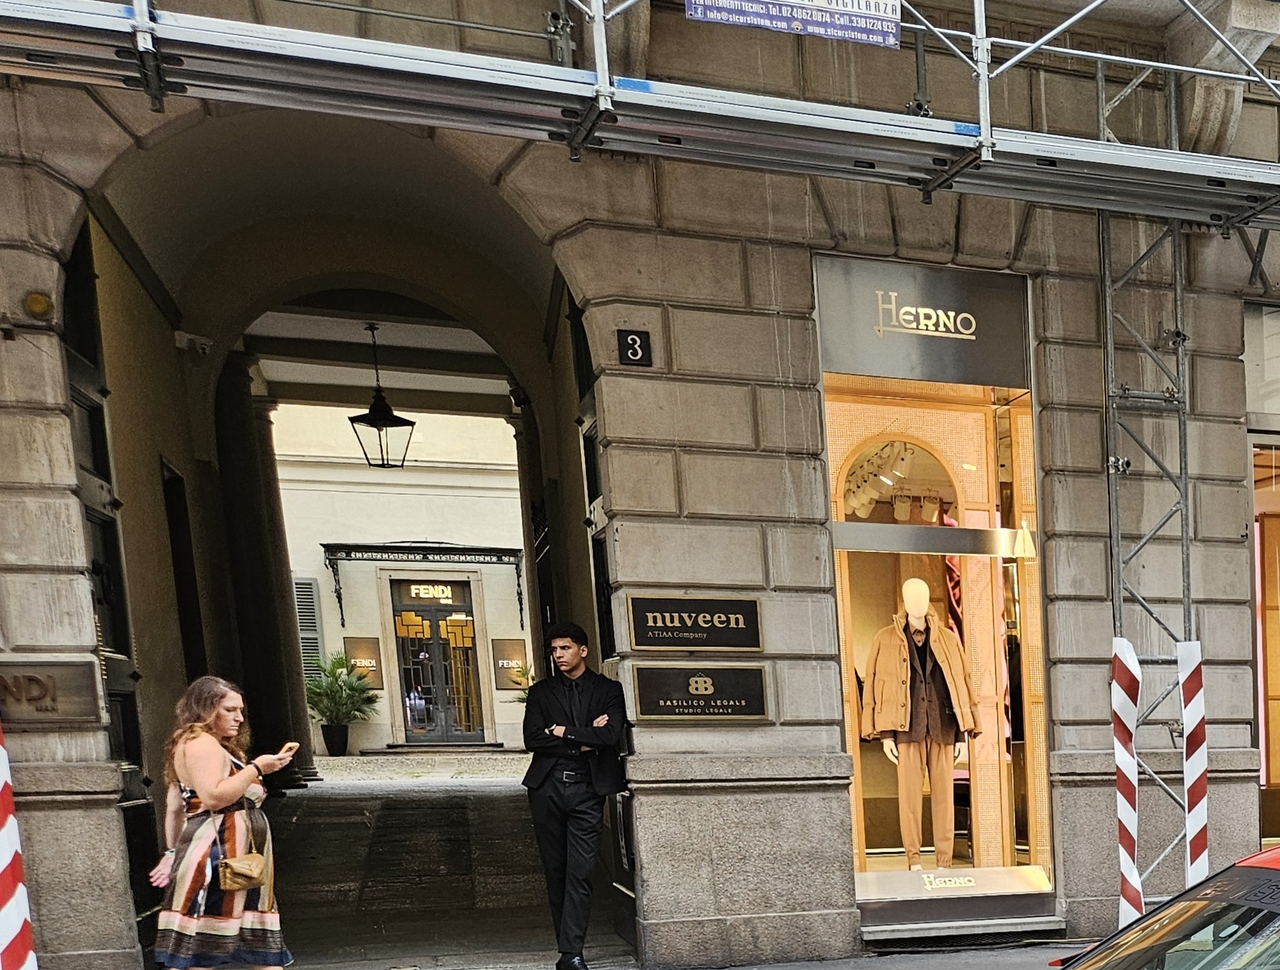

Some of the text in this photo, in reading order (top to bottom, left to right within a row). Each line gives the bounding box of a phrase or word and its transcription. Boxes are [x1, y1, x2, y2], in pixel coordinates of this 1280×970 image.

[627, 335, 643, 360] 3
[410, 584, 453, 599] FENDI
[645, 612, 746, 628] nuveen
[673, 631, 707, 639] Company
[0, 673, 56, 702] NDI
